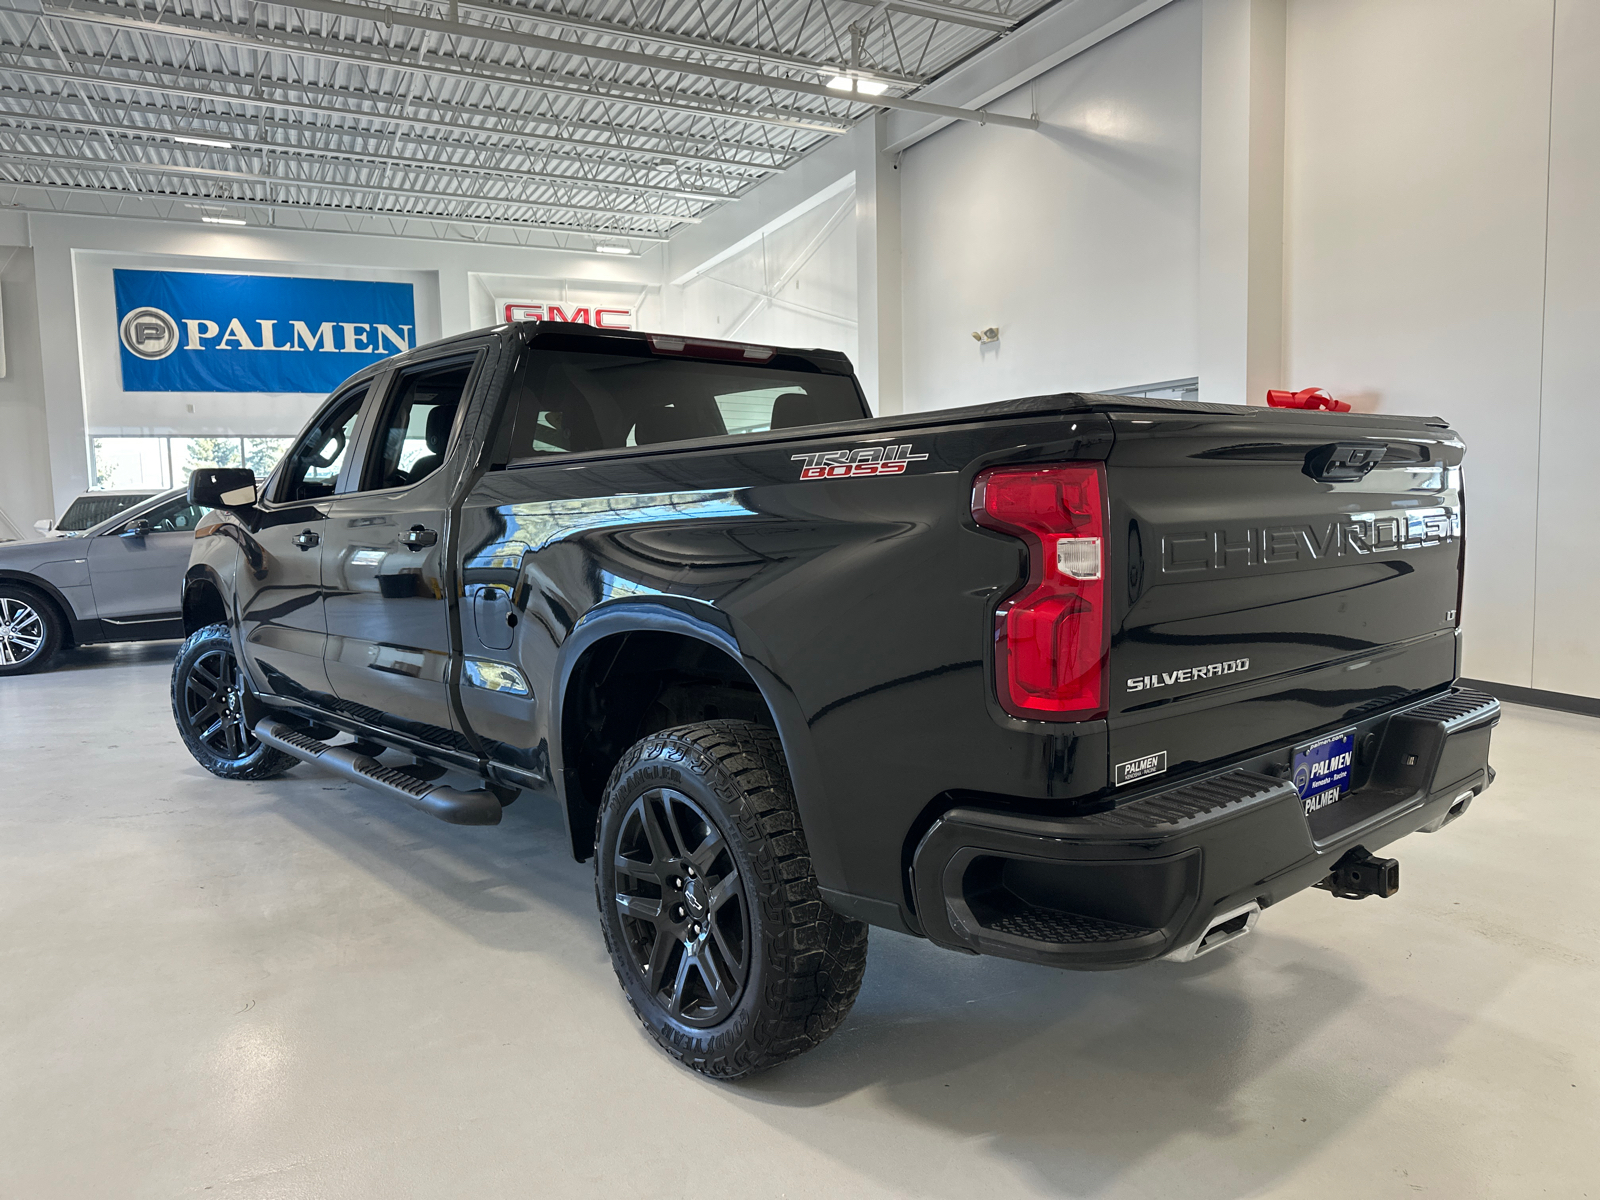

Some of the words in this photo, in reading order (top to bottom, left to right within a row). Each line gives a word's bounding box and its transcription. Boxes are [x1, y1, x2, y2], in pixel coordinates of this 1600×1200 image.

[503, 302, 632, 330] GMC
[181, 317, 413, 354] PALMEN
[790, 444, 929, 468] TRAIL
[800, 460, 907, 480] BOSS
[1161, 512, 1458, 573] CHEVROLET
[1126, 657, 1249, 692] SILVERADO
[1124, 756, 1159, 775] PALMEN
[1311, 751, 1352, 778] PALMEN
[609, 764, 683, 815] WRANGLER
[1312, 778, 1331, 788] Kenosha
[1333, 771, 1347, 781] Racine
[1306, 787, 1339, 813] PALMEN
